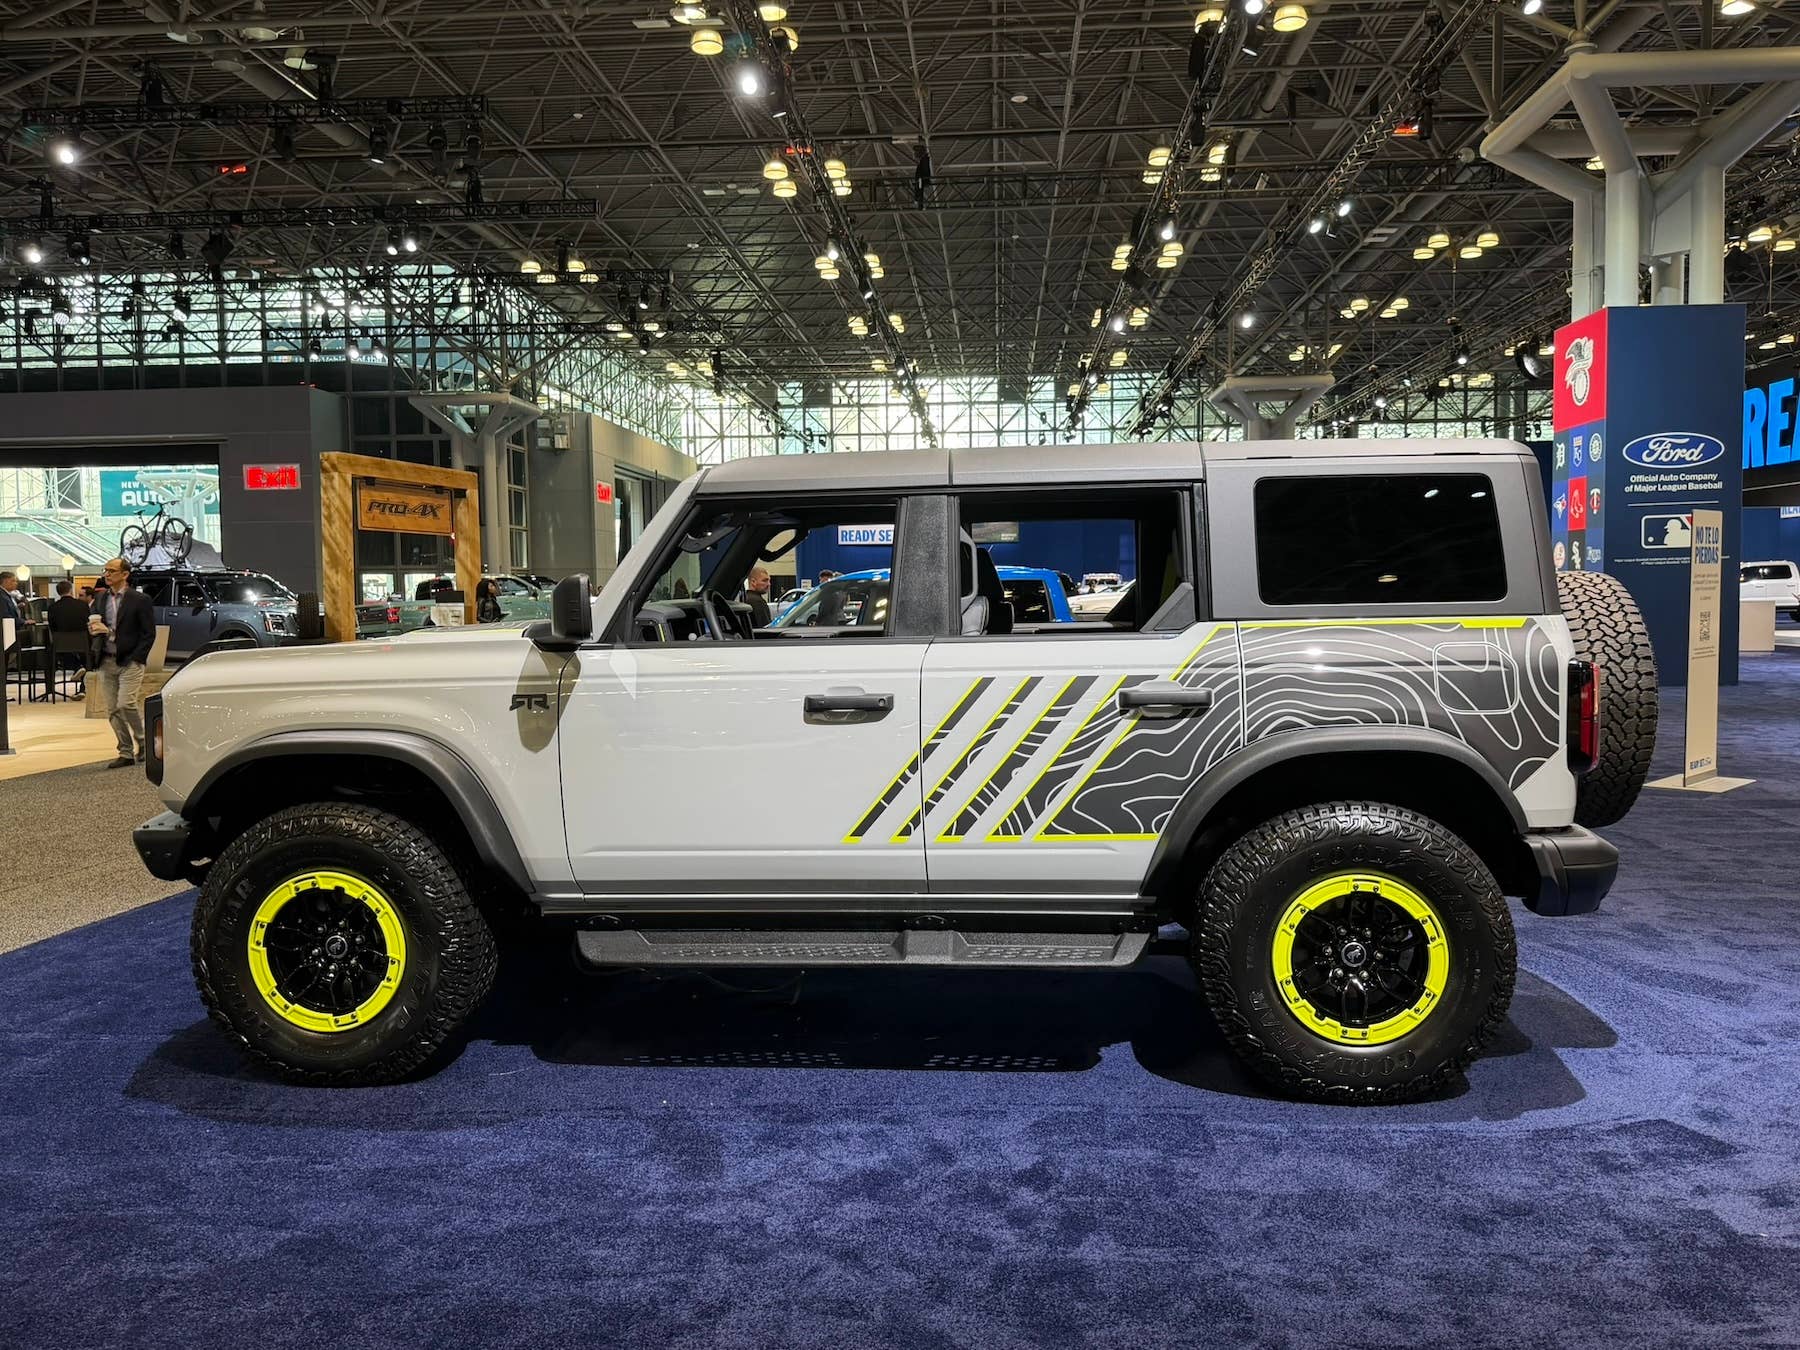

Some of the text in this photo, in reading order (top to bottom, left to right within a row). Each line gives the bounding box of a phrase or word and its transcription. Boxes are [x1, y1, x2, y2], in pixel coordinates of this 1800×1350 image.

[1642, 437, 1706, 463] Ford
[247, 466, 298, 489] Exit
[1629, 473, 1719, 483] Official Auto Company
[1624, 481, 1723, 493] of Major League Baseball
[841, 529, 876, 542] READY
[1696, 526, 1719, 544] NO TE LO
[1695, 546, 1719, 564] PIERDAS
